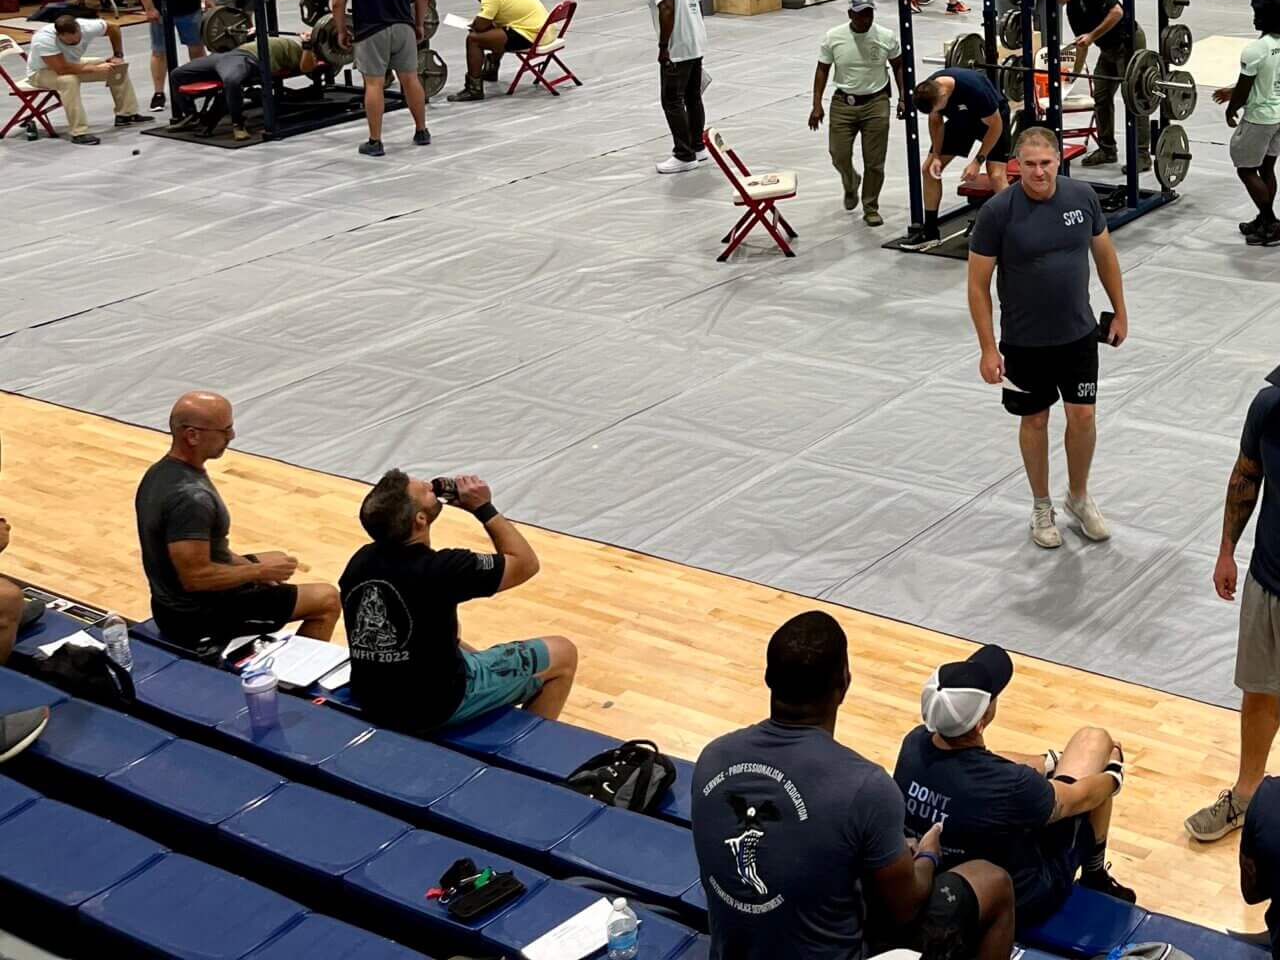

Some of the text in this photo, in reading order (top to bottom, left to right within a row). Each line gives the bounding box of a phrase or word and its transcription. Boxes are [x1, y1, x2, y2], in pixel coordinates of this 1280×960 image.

[1063, 209, 1085, 226] SPD
[1077, 382, 1096, 397] SPD
[378, 650, 410, 663] 2022
[702, 762, 809, 821] SERVICE PROFESSIONALISM DEDICATION
[908, 780, 952, 811] DON'T
[906, 798, 950, 824] QUIT
